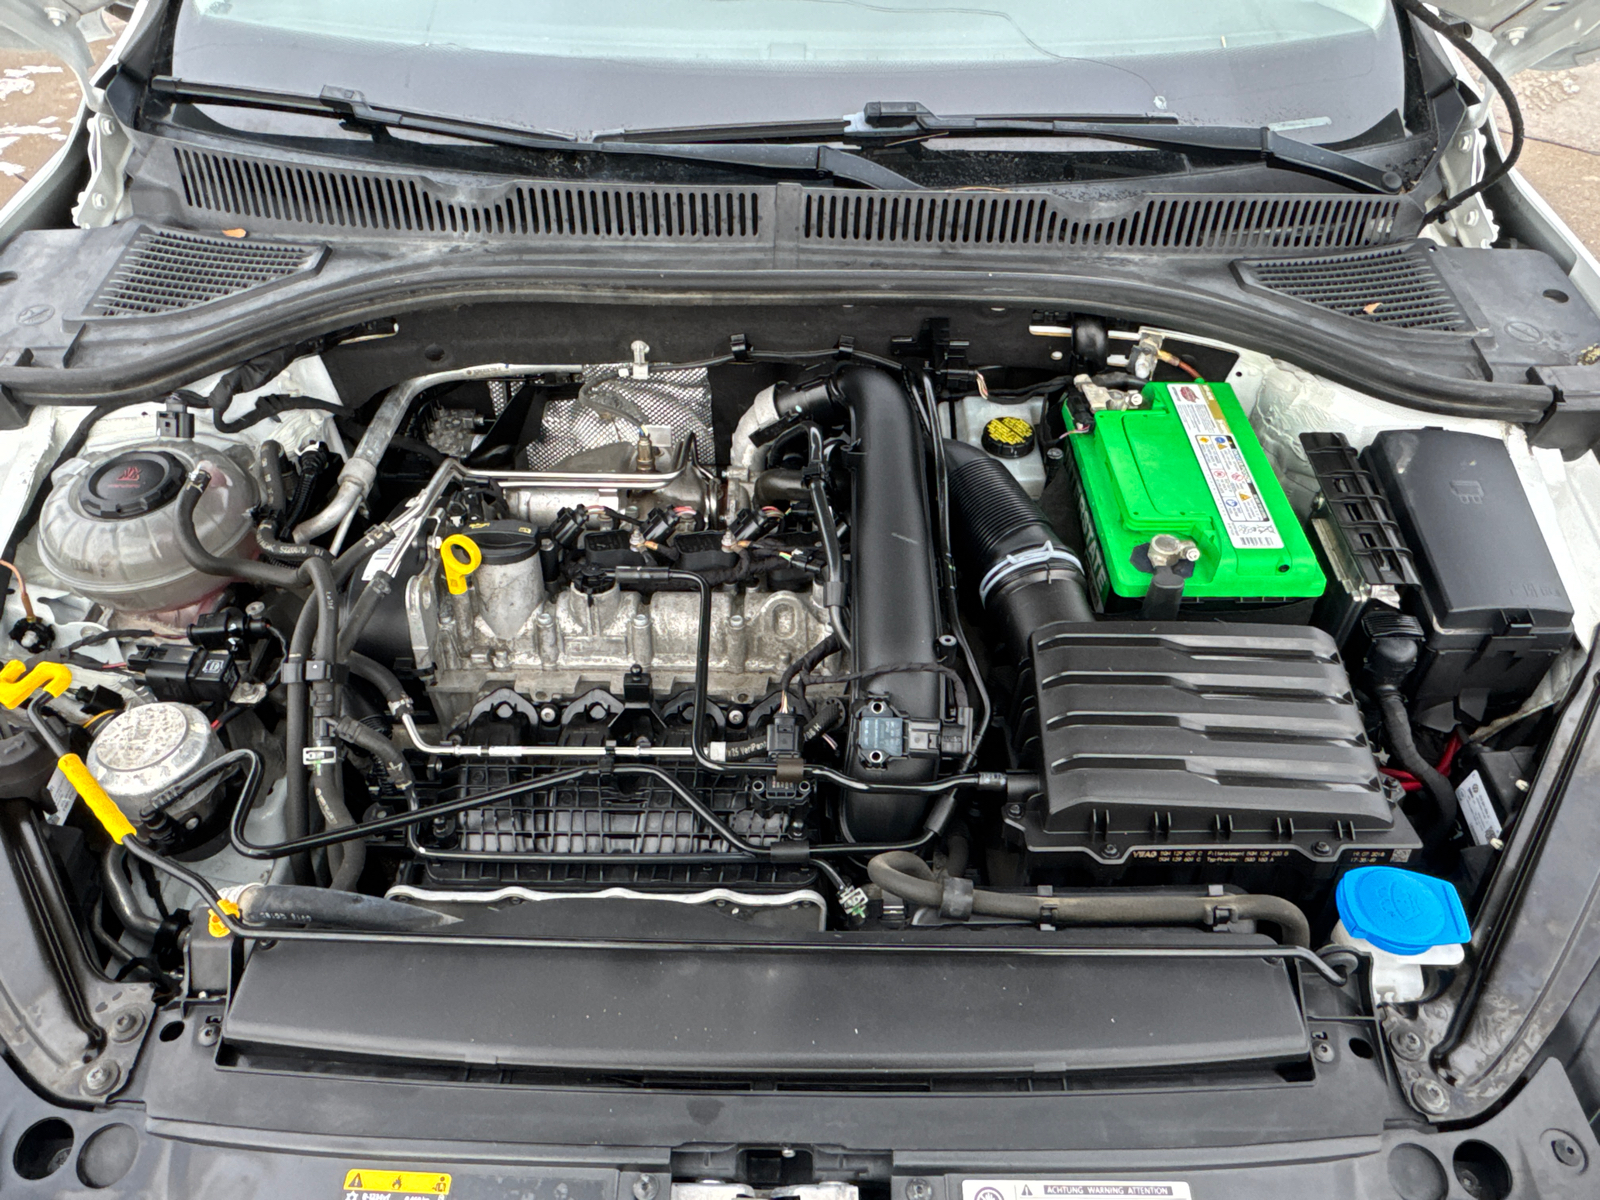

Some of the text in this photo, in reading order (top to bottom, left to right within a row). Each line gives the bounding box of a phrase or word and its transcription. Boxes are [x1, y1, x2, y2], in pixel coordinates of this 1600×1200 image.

[1047, 1186, 1168, 1195] ACHTUNG WARNING ATTENTION
